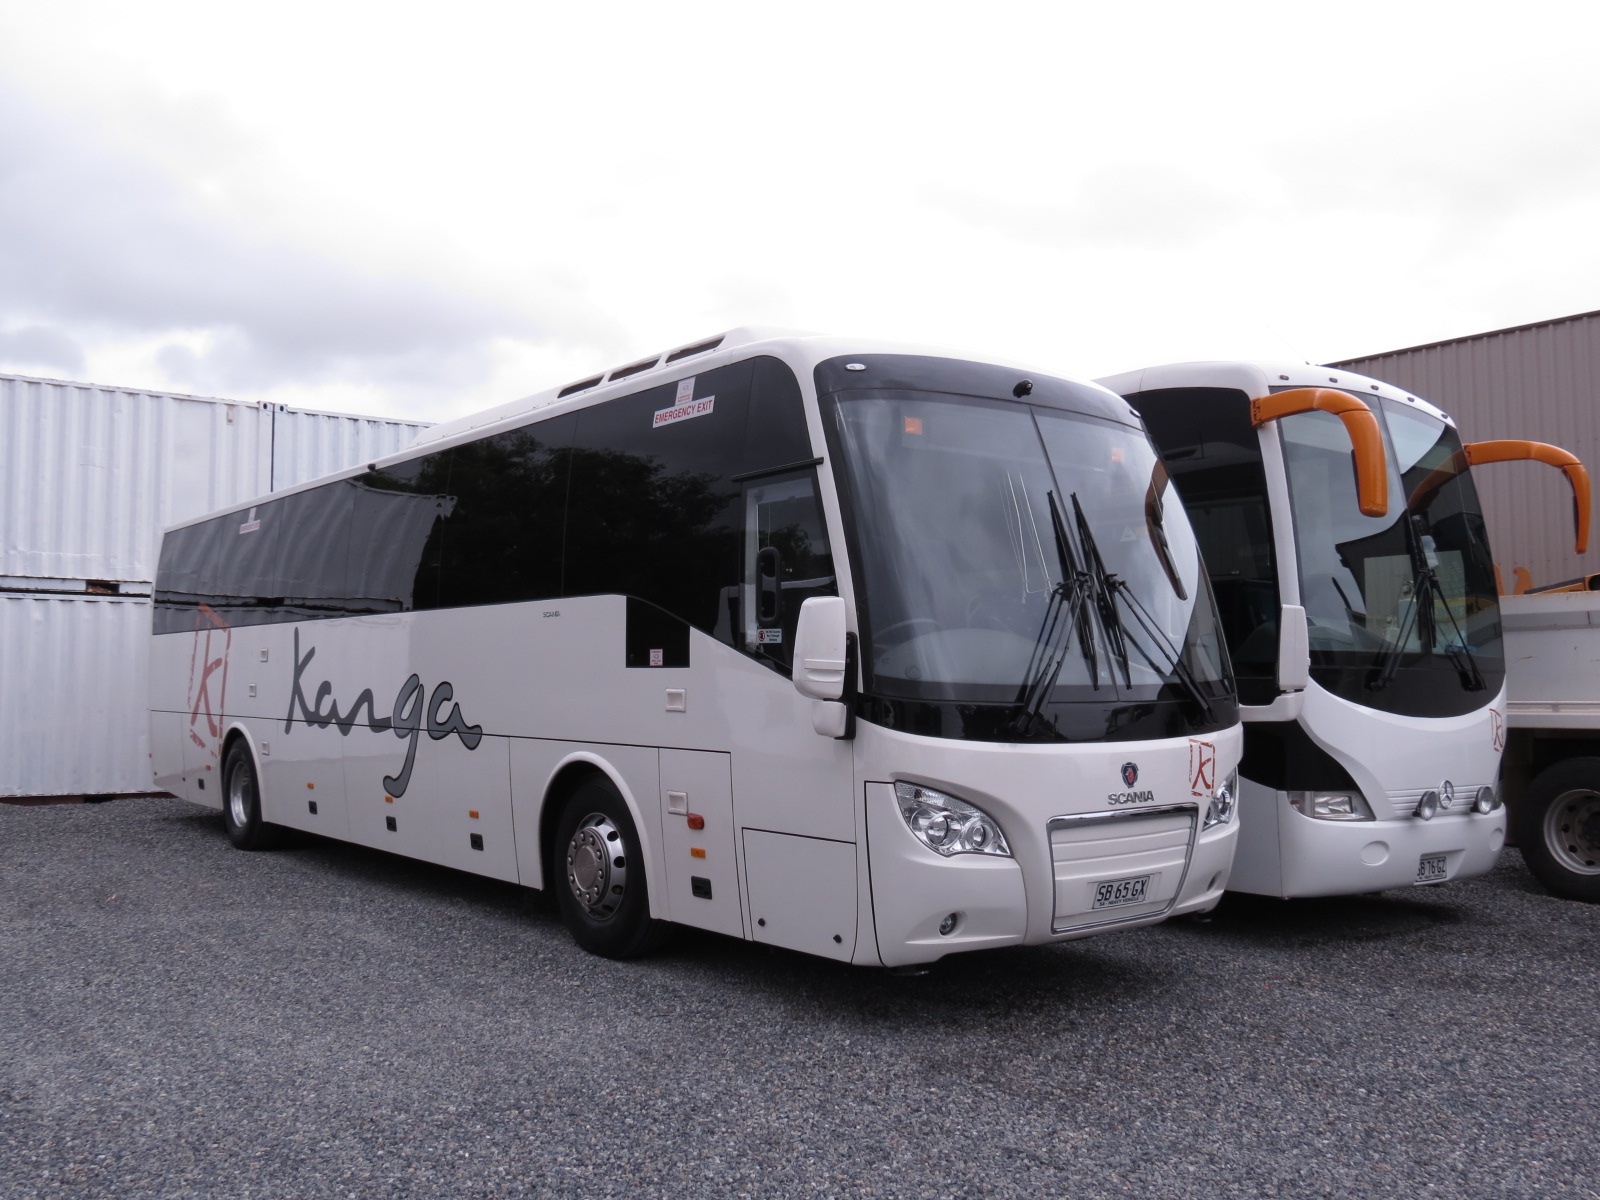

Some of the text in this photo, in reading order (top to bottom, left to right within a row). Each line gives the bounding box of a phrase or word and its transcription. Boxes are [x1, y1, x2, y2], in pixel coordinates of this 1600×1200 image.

[655, 400, 713, 424] EMERGENCY EXIT
[1107, 790, 1155, 806] SCANIA
